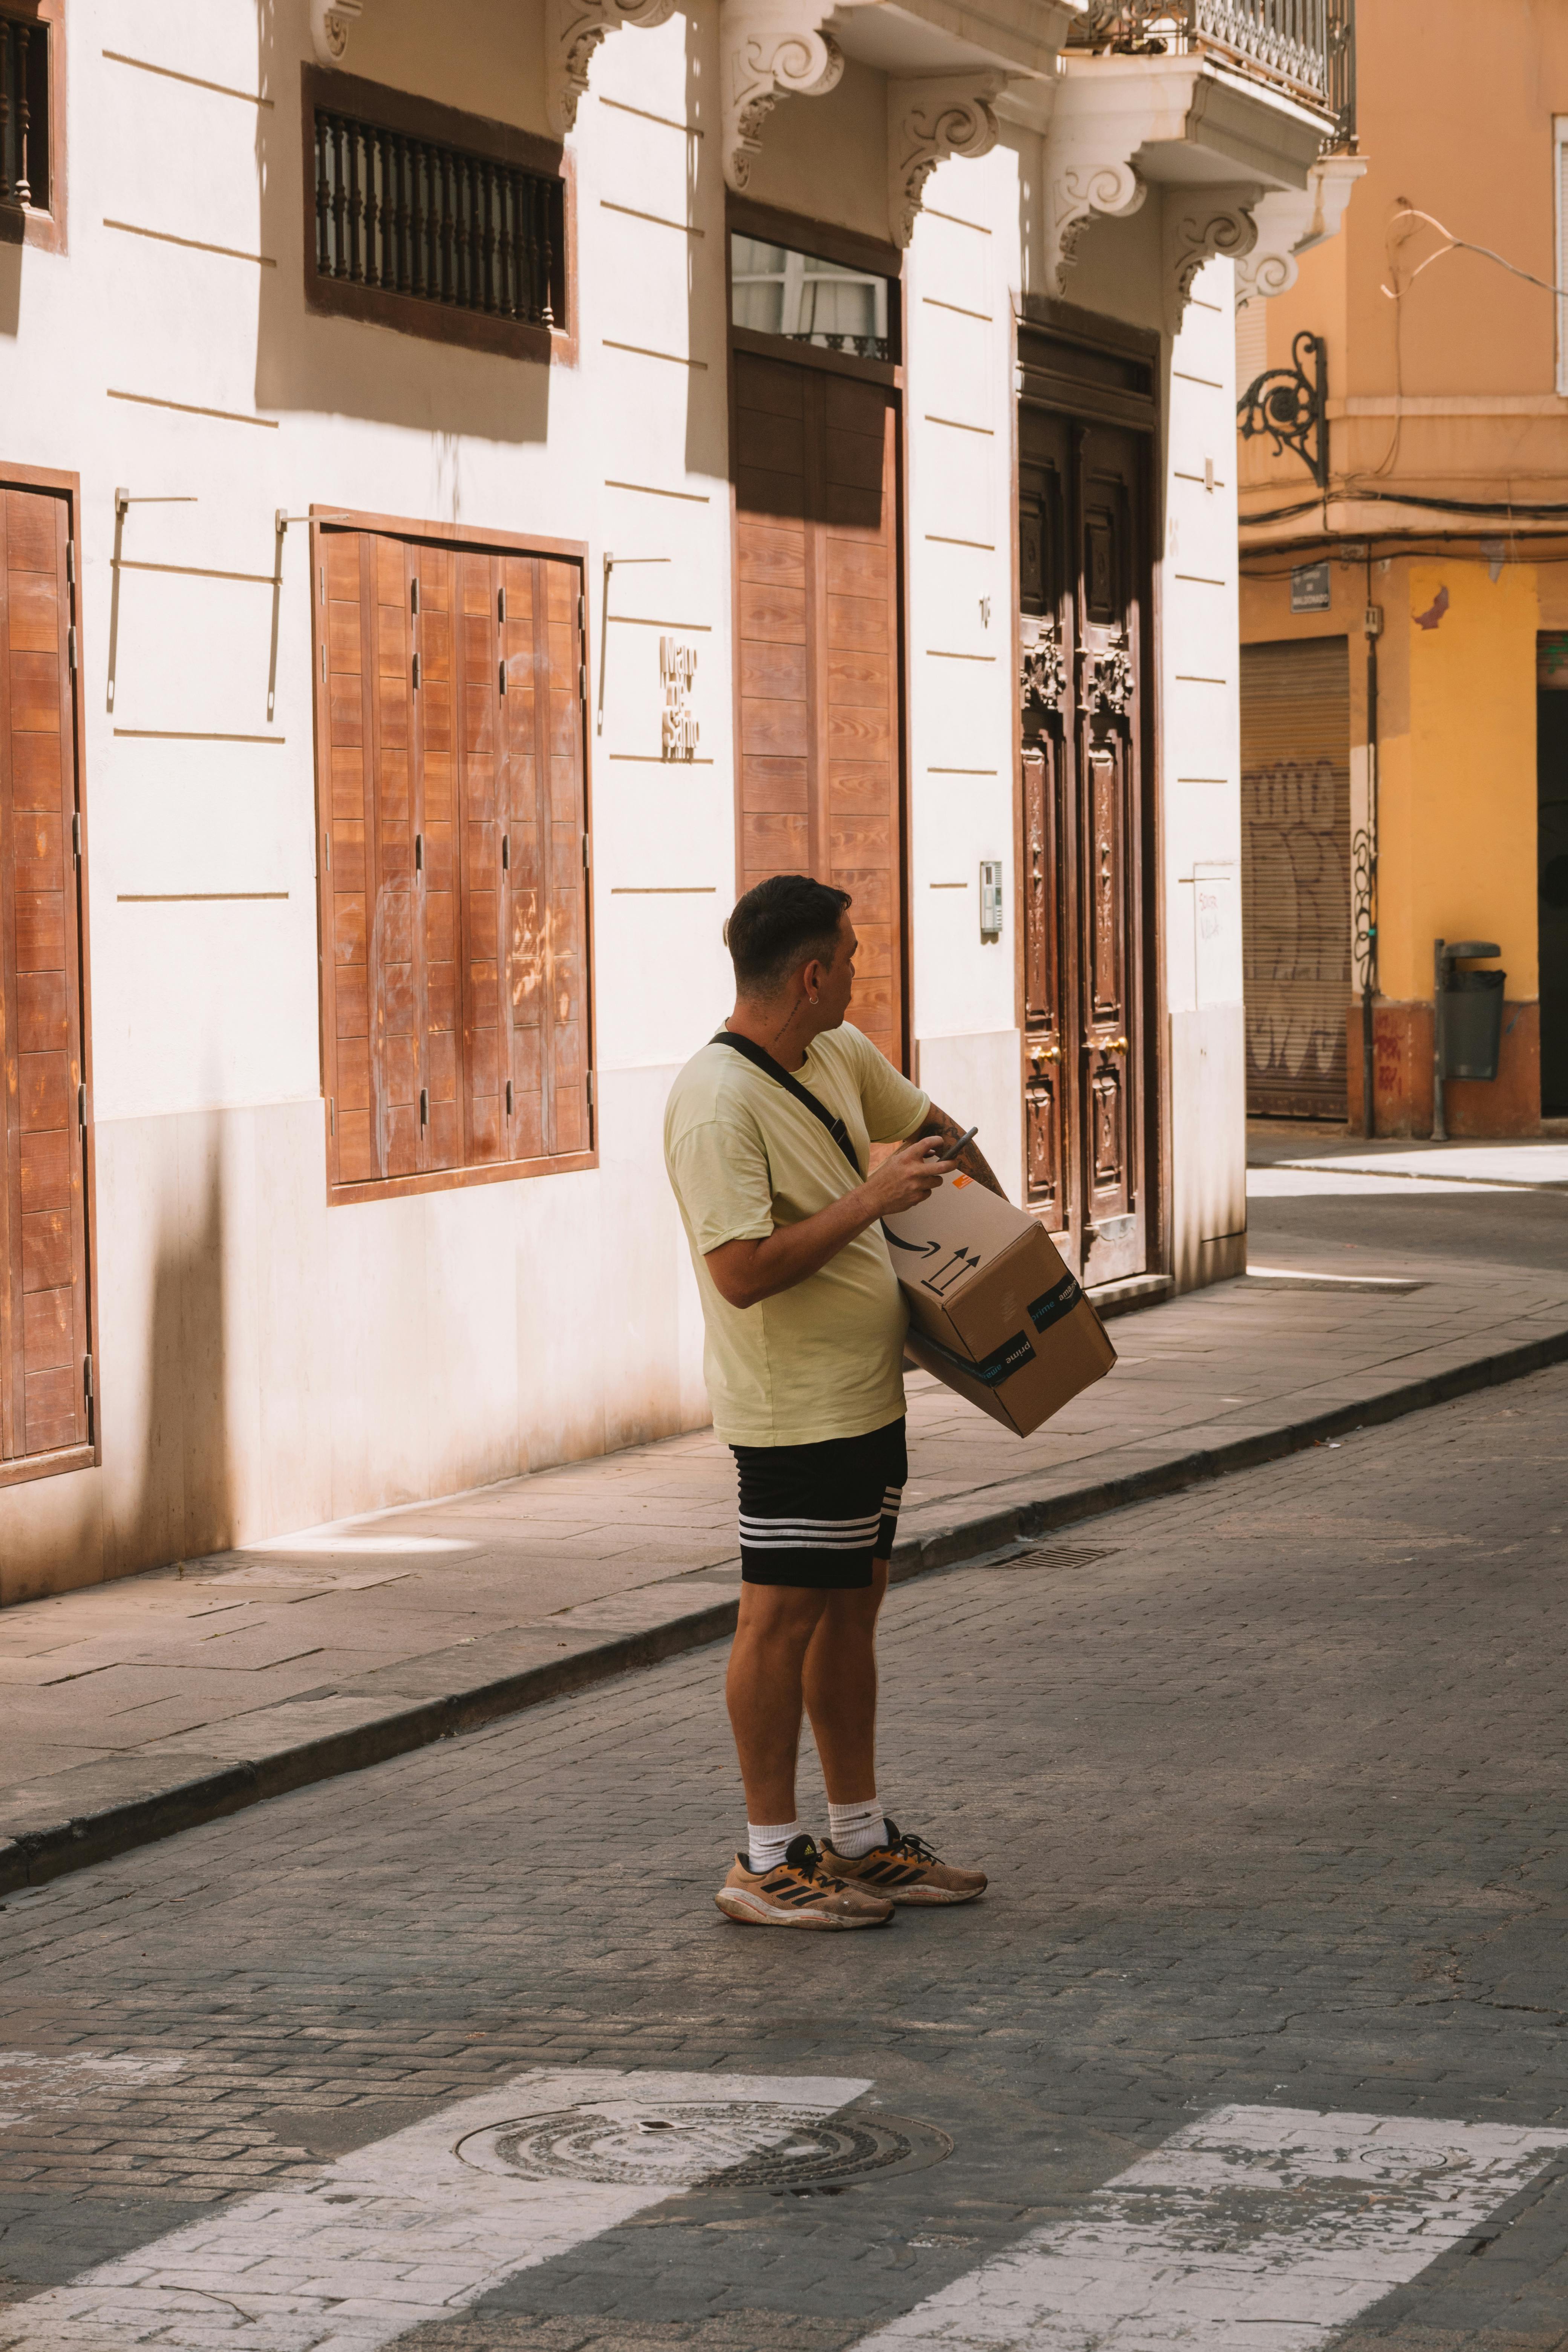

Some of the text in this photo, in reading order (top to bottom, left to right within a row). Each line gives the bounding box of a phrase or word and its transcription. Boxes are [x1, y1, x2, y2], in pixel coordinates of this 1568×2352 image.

[660, 636, 698, 676] Mano
[662, 705, 700, 748] Santo
[1059, 1280, 1077, 1300] amazo
[1006, 1341, 1031, 1363] prime
